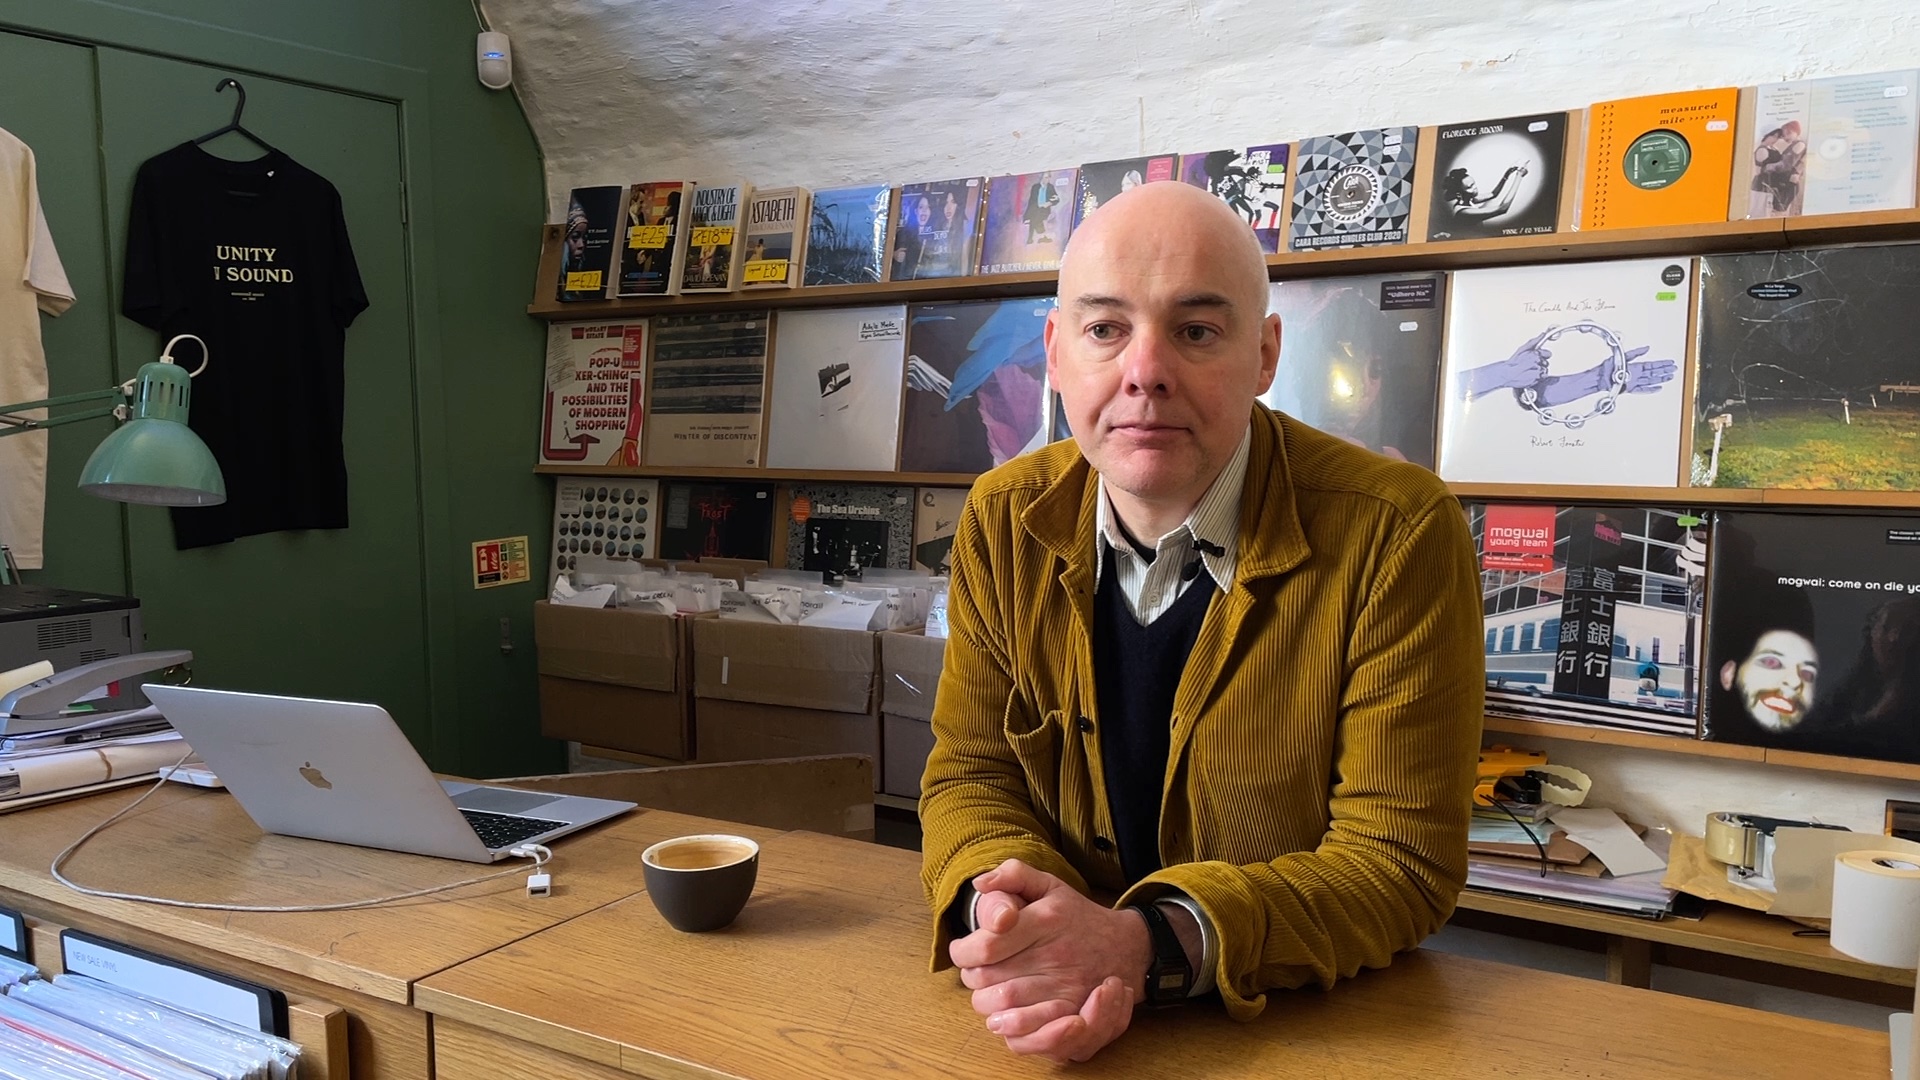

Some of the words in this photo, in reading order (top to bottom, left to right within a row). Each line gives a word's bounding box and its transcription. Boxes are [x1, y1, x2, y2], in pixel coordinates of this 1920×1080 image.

[1660, 102, 1718, 114] measured
[1659, 116, 1685, 125] mile
[1442, 127, 1478, 139] FLORENCE
[695, 188, 728, 206] INDUSTRY
[727, 188, 737, 204] OF
[717, 203, 738, 221] LIGHT
[1312, 235, 1340, 246] RECORDS
[1340, 233, 1367, 244] SINGLES
[1366, 232, 1383, 242] CLUB
[1383, 231, 1401, 240] 2020
[216, 245, 277, 262] UNITY
[226, 267, 294, 283] SOUND
[1523, 301, 1536, 313] The
[1538, 301, 1562, 313] Candle
[1566, 301, 1580, 312] And
[1580, 298, 1592, 311] The
[586, 382, 607, 393] AND
[610, 382, 628, 393] THE
[562, 395, 628, 406] POSSIBILITIES
[569, 407, 582, 418] OF
[583, 407, 627, 418] MODERN
[575, 419, 626, 431] SHOPPING
[816, 503, 831, 514] The
[831, 504, 847, 514] Sea
[847, 505, 881, 516] Urchins
[1490, 527, 1549, 539] mogwai
[1489, 538, 1520, 547] young
[1522, 538, 1548, 547] team
[1777, 577, 1826, 588] mogwai:
[1828, 579, 1862, 589] come
[1864, 582, 1881, 590] on
[1883, 581, 1904, 591] die
[1584, 566, 1616, 678] 富士銀行
[72, 950, 87, 962] NEW
[87, 954, 101, 968] SALE
[101, 960, 118, 973] VINYL
